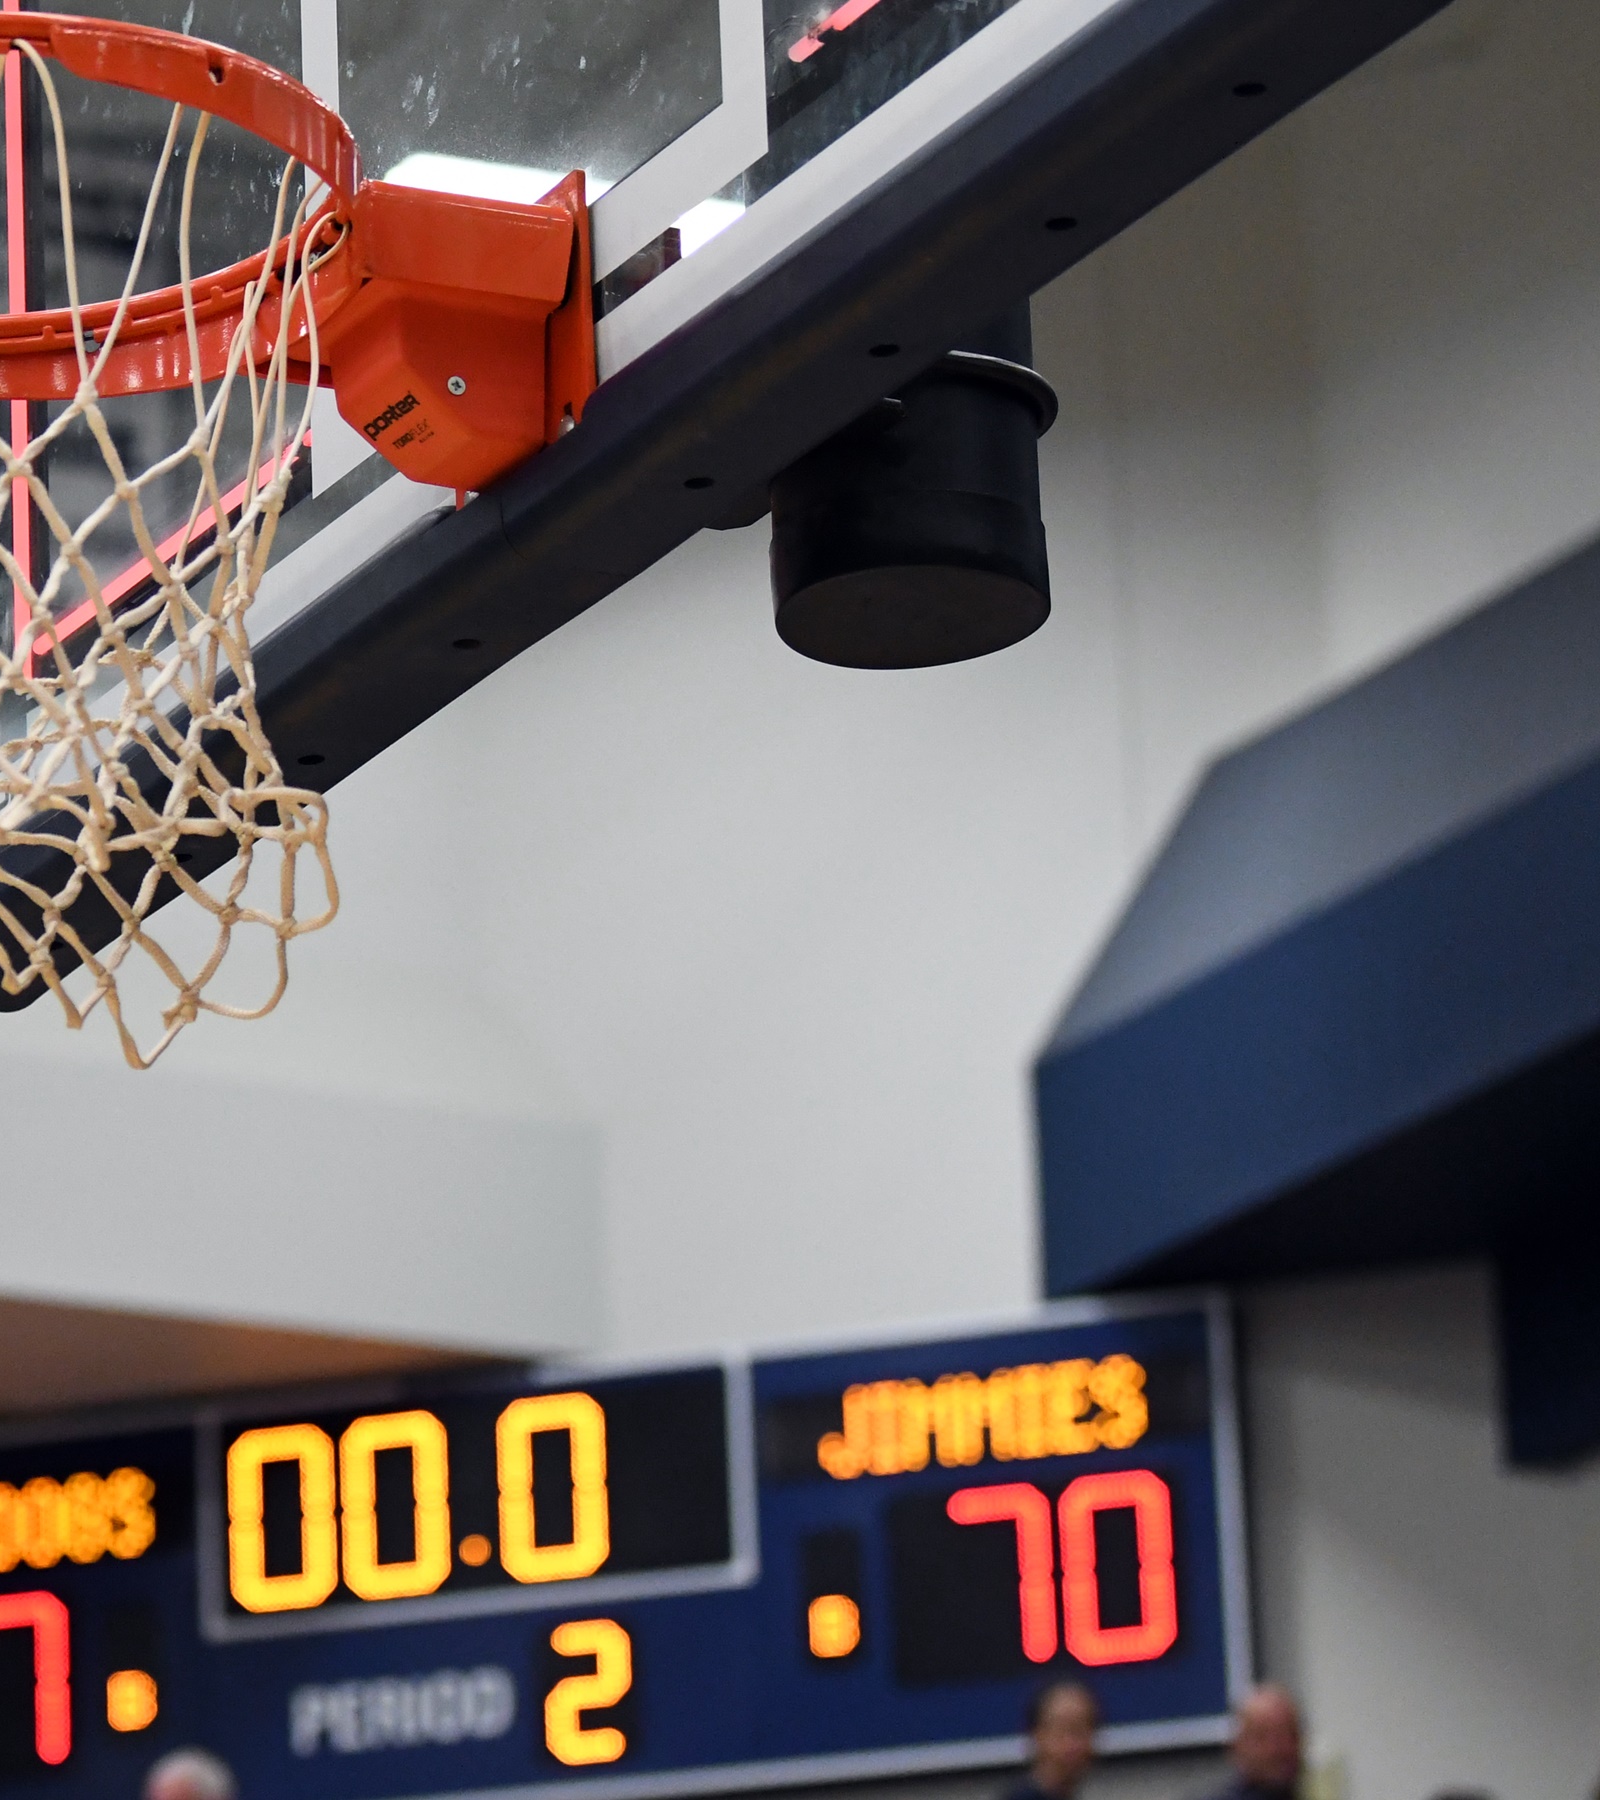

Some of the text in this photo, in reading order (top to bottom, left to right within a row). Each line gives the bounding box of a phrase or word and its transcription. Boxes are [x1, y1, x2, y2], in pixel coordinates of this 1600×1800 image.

[817, 1353, 1149, 1480] JIMMIES
[227, 1392, 610, 1614] 00.0
[946, 1469, 1178, 1666] 70
[289, 1664, 518, 1757] PERIOD
[545, 1618, 632, 1766] 2
